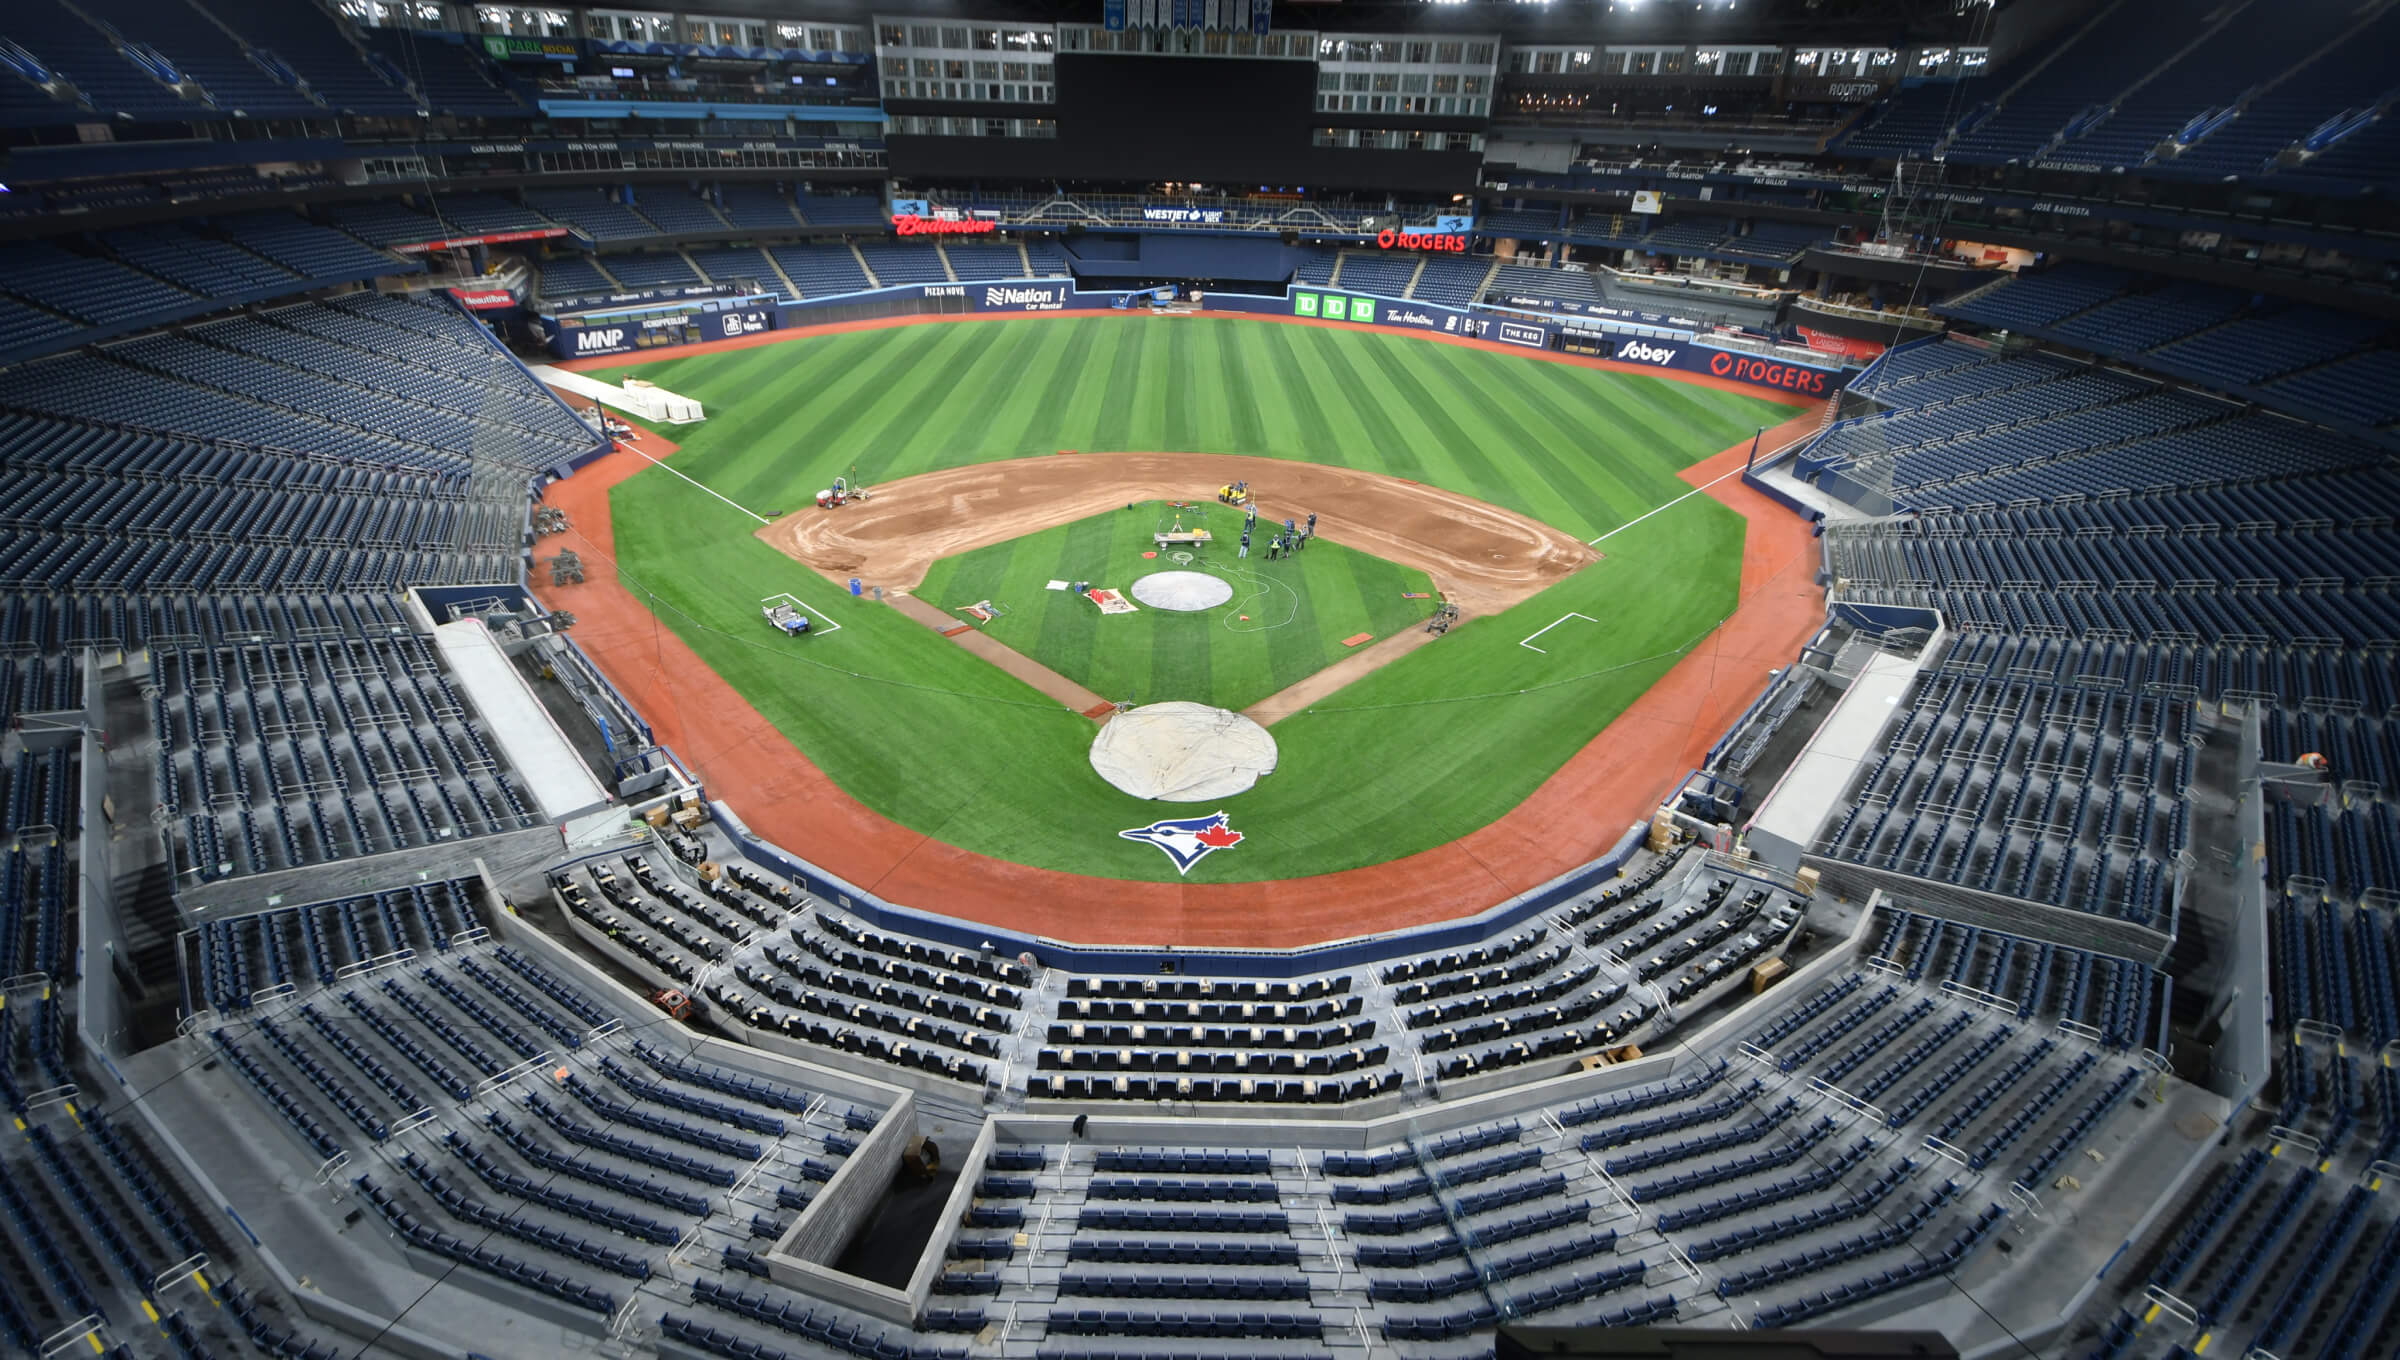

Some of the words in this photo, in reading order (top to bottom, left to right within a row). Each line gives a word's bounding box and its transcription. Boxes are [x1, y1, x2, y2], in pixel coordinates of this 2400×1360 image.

[488, 39, 505, 55] TD
[507, 39, 541, 53] PARK
[1828, 83, 1879, 96] ROOFTOP
[496, 144, 524, 152] DELGADO
[2036, 160, 2061, 171] JACKIE
[2061, 161, 2102, 173] ROBINSON
[1681, 172, 1704, 180] GASTON
[1753, 177, 1765, 185] PAT
[1765, 178, 1788, 187] GILLICK
[1842, 184, 1857, 192] PAUL
[1949, 193, 1985, 204] HALLADAY
[1143, 208, 1189, 222] WESTJET
[2053, 204, 2090, 217] BAUTISTA
[891, 214, 995, 235] Budweiser
[1397, 231, 1466, 252] ROGERS
[924, 286, 945, 297] PIZZA
[946, 286, 966, 296] NOVA
[1004, 288, 1065, 304] Nationl
[1039, 302, 1063, 310] Rental
[1298, 296, 1316, 312] TD
[1326, 299, 1344, 315] TD
[1354, 301, 1372, 317] TD
[1387, 309, 1402, 321] Tim
[1403, 311, 1434, 326] Hortons
[1464, 318, 1490, 334] BT
[578, 328, 624, 350] MNP
[1505, 328, 1521, 338] THE
[1522, 331, 1538, 341] KEG
[1735, 358, 1826, 393] ROGERS
